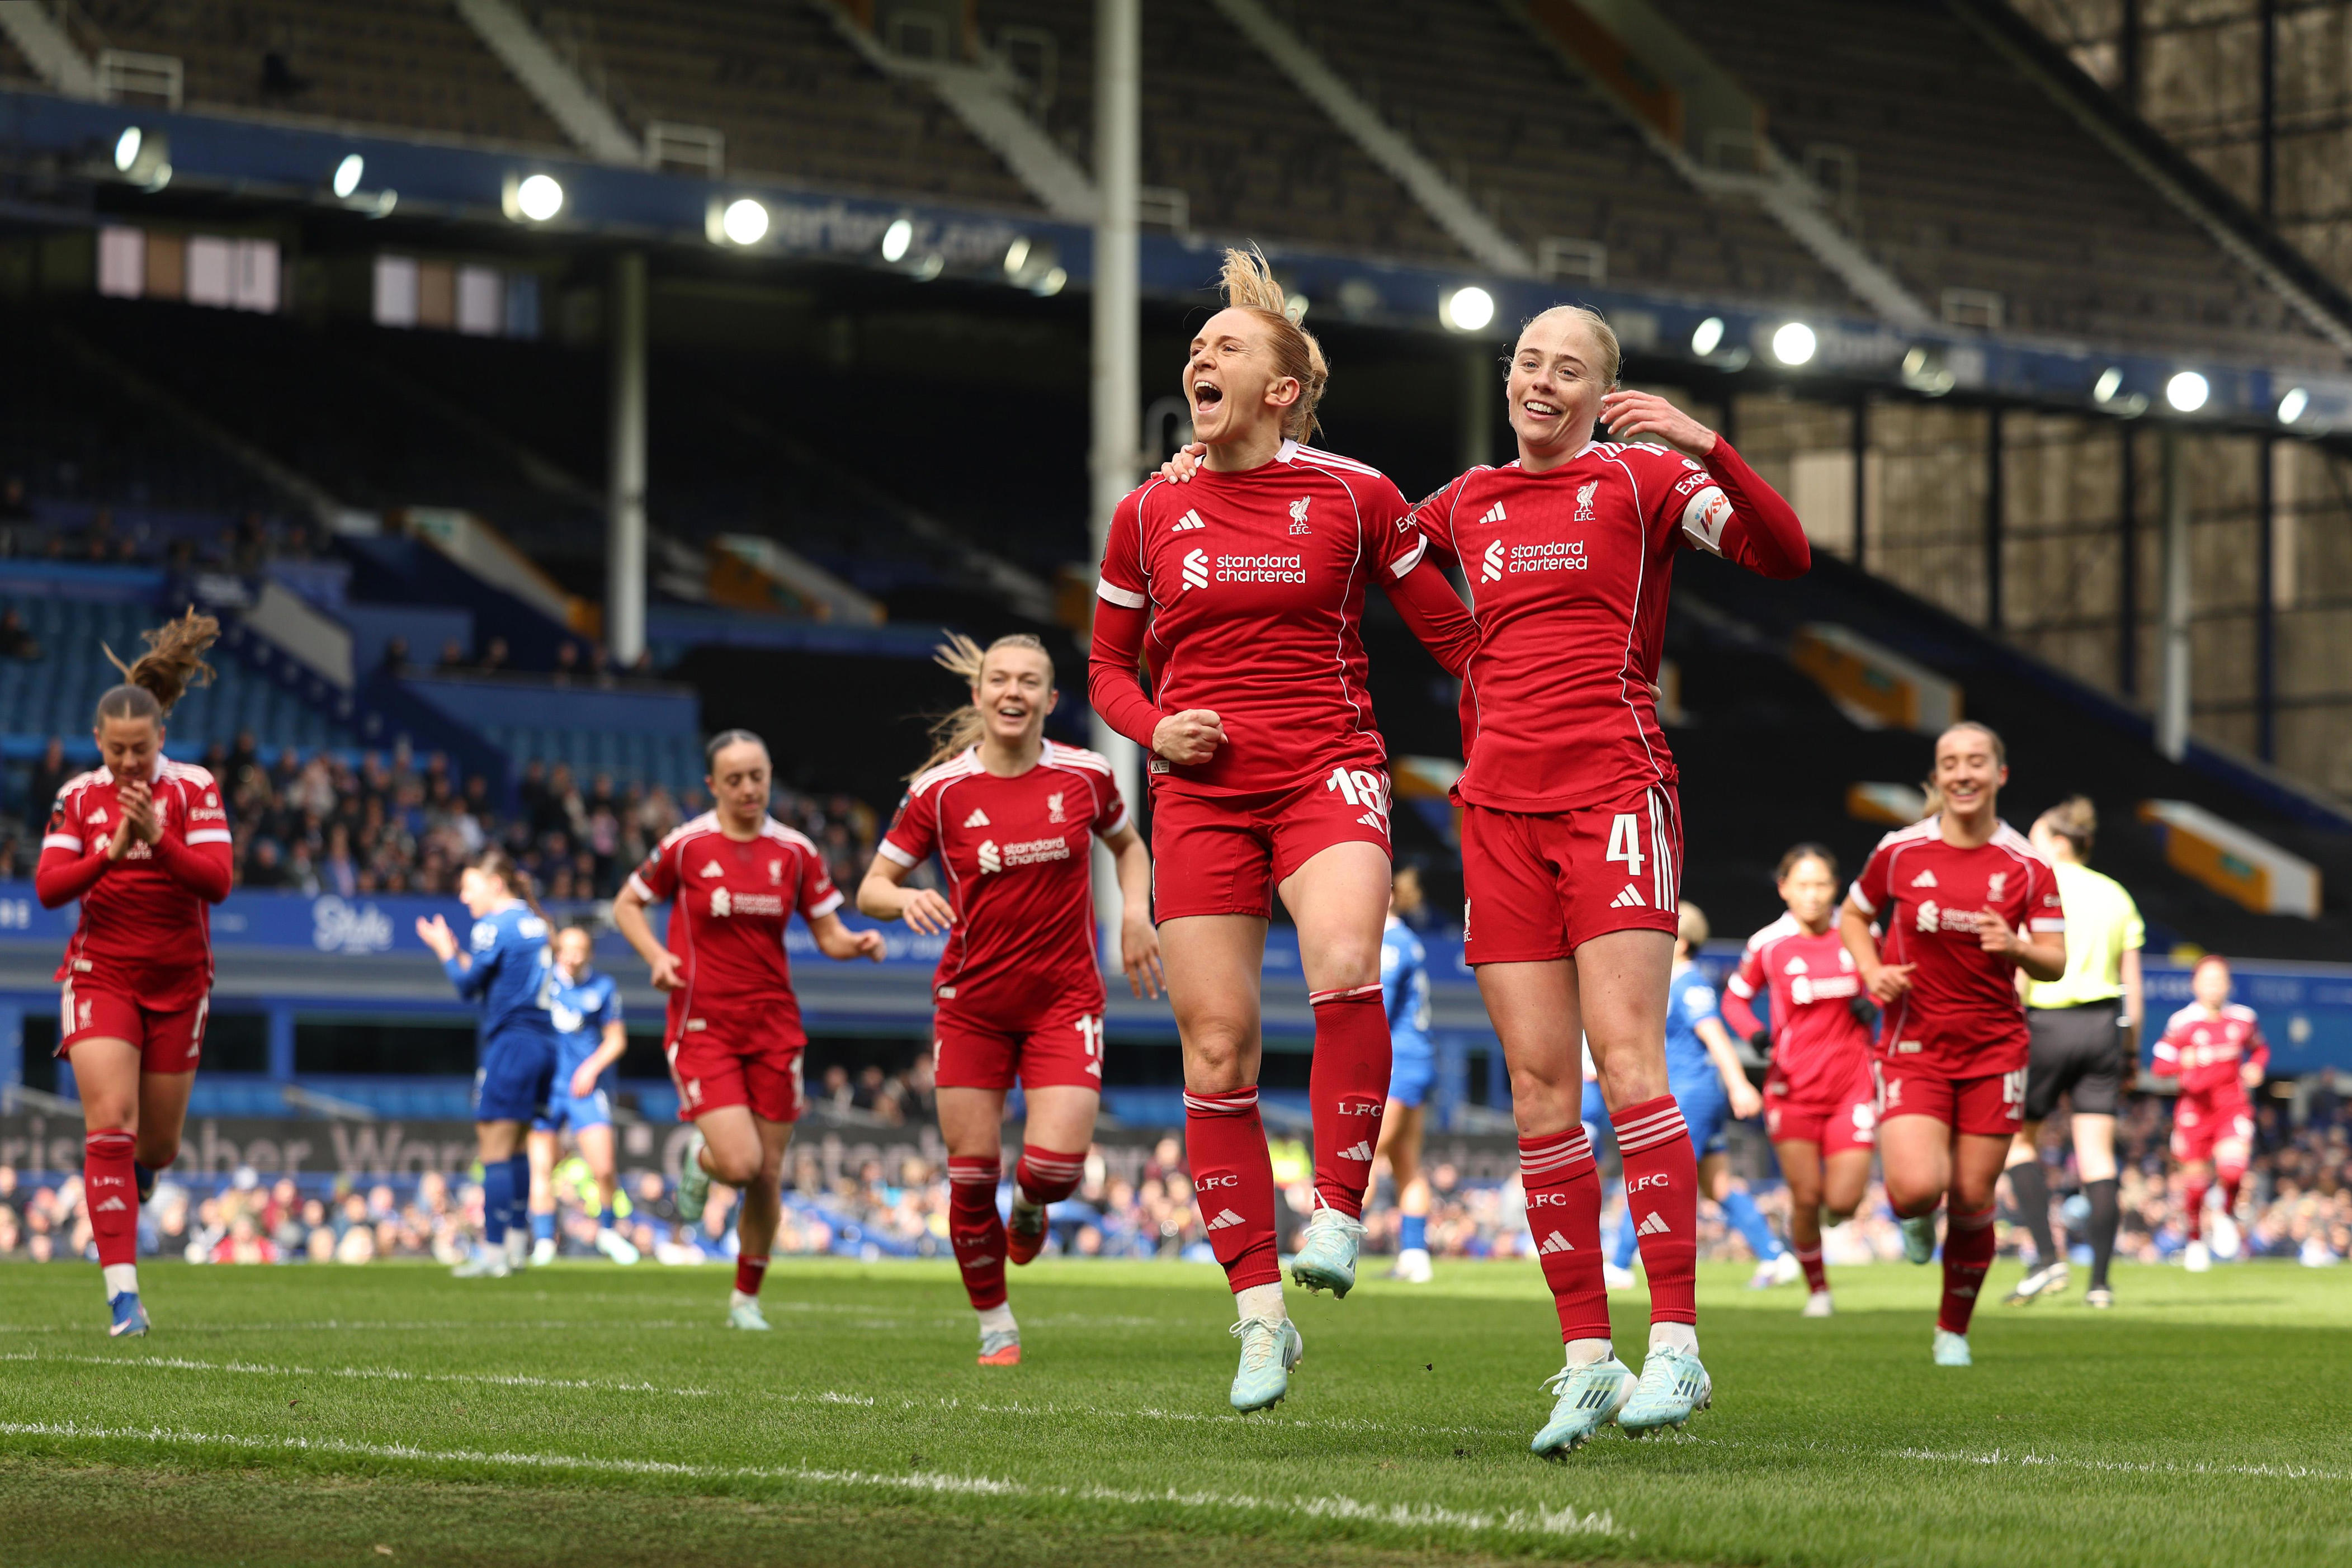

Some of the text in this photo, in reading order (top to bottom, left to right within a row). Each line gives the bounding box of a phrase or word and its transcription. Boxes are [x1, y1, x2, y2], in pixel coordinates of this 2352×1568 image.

[1574, 512, 1596, 522] L.F.C.
[1701, 494, 1729, 536] WSL
[1288, 526, 1312, 535] L.F.C.
[1510, 540, 1584, 559] standard
[1216, 554, 1300, 569] standard
[1508, 555, 1588, 573] chartered
[1216, 568, 1306, 584] chartered
[1326, 767, 1383, 815] 18
[1003, 836, 1065, 856] standard
[1606, 814, 1645, 876] 4
[1004, 846, 1070, 866] chartered
[1338, 1102, 1382, 1117] LFC
[330, 1121, 476, 1178] War
[92, 1175, 125, 1188] LFC
[1195, 1175, 1238, 1192] LFC
[1628, 1173, 1669, 1194] LFC
[1526, 1193, 1566, 1210] LFC
